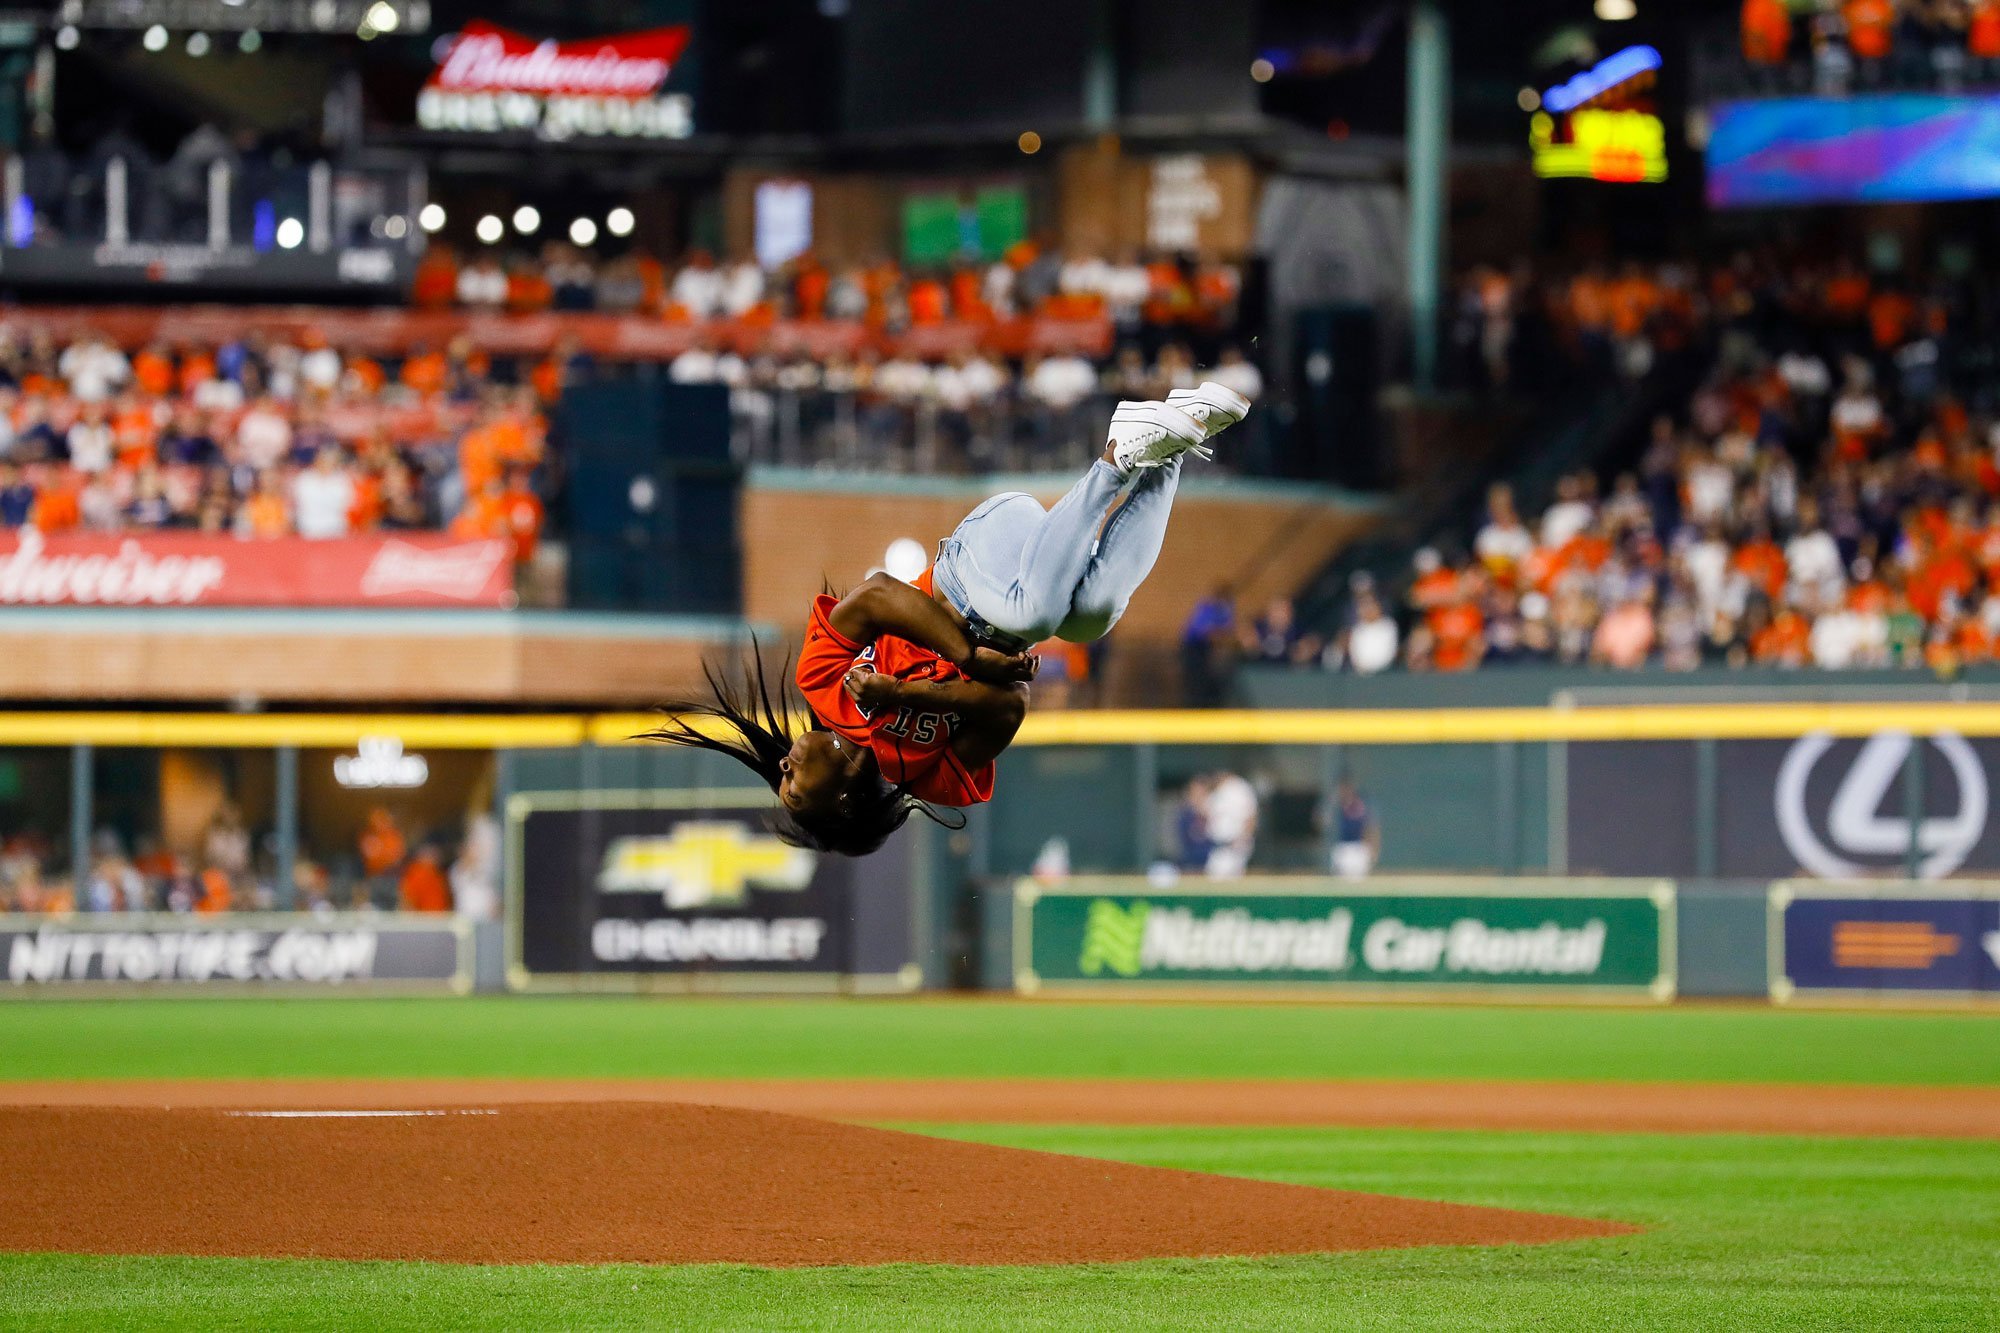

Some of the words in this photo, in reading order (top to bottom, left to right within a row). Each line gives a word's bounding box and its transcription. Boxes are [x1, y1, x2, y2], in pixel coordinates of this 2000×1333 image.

[434, 32, 669, 90] Budweiser
[592, 917, 823, 962] CHEVROLET
[1142, 906, 1353, 972] National
[1362, 917, 1446, 973] Car
[1446, 917, 1607, 974] Rental
